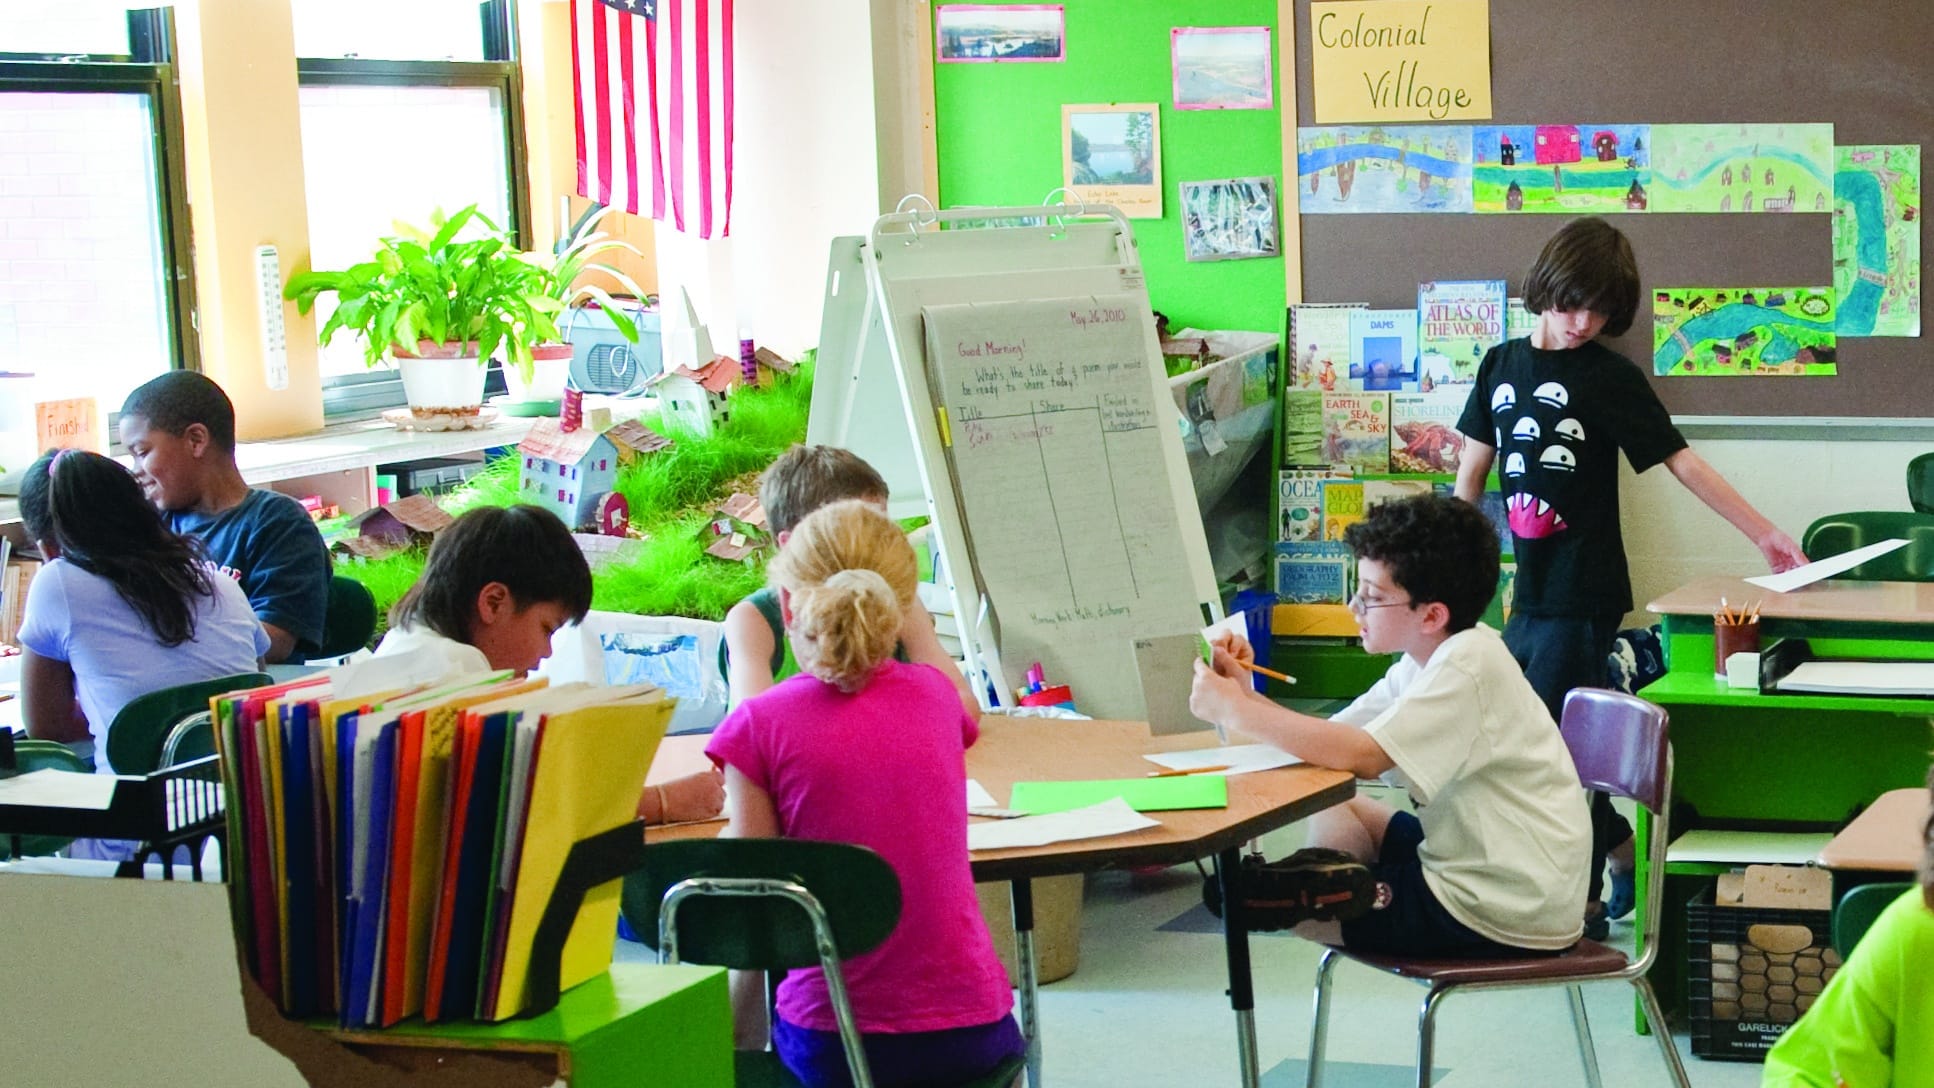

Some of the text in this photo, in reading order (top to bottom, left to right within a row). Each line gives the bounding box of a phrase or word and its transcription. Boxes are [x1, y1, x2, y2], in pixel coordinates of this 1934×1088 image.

[1319, 5, 1432, 48] Colonial
[1363, 60, 1472, 119] Village
[1070, 310, 1087, 328] May
[1104, 309, 1126, 323] 2010
[1425, 303, 1473, 322] ATLAS
[1477, 303, 1500, 321] OF
[1370, 320, 1395, 329] DAMS
[1425, 322, 1501, 337] THE WORLD
[958, 339, 1026, 361] Good Morning!
[975, 366, 1005, 383] What's
[1010, 365, 1024, 378] the
[1030, 363, 1049, 376] title
[962, 380, 972, 396] be
[975, 382, 999, 398] ready
[1005, 379, 1016, 392] to
[1024, 378, 1045, 390] share
[1326, 399, 1360, 409] EARTH
[957, 406, 983, 420] Title
[1350, 410, 1370, 420] SEA
[1367, 423, 1388, 433] SKY
[1738, 1022, 1788, 1033] GARELICK
